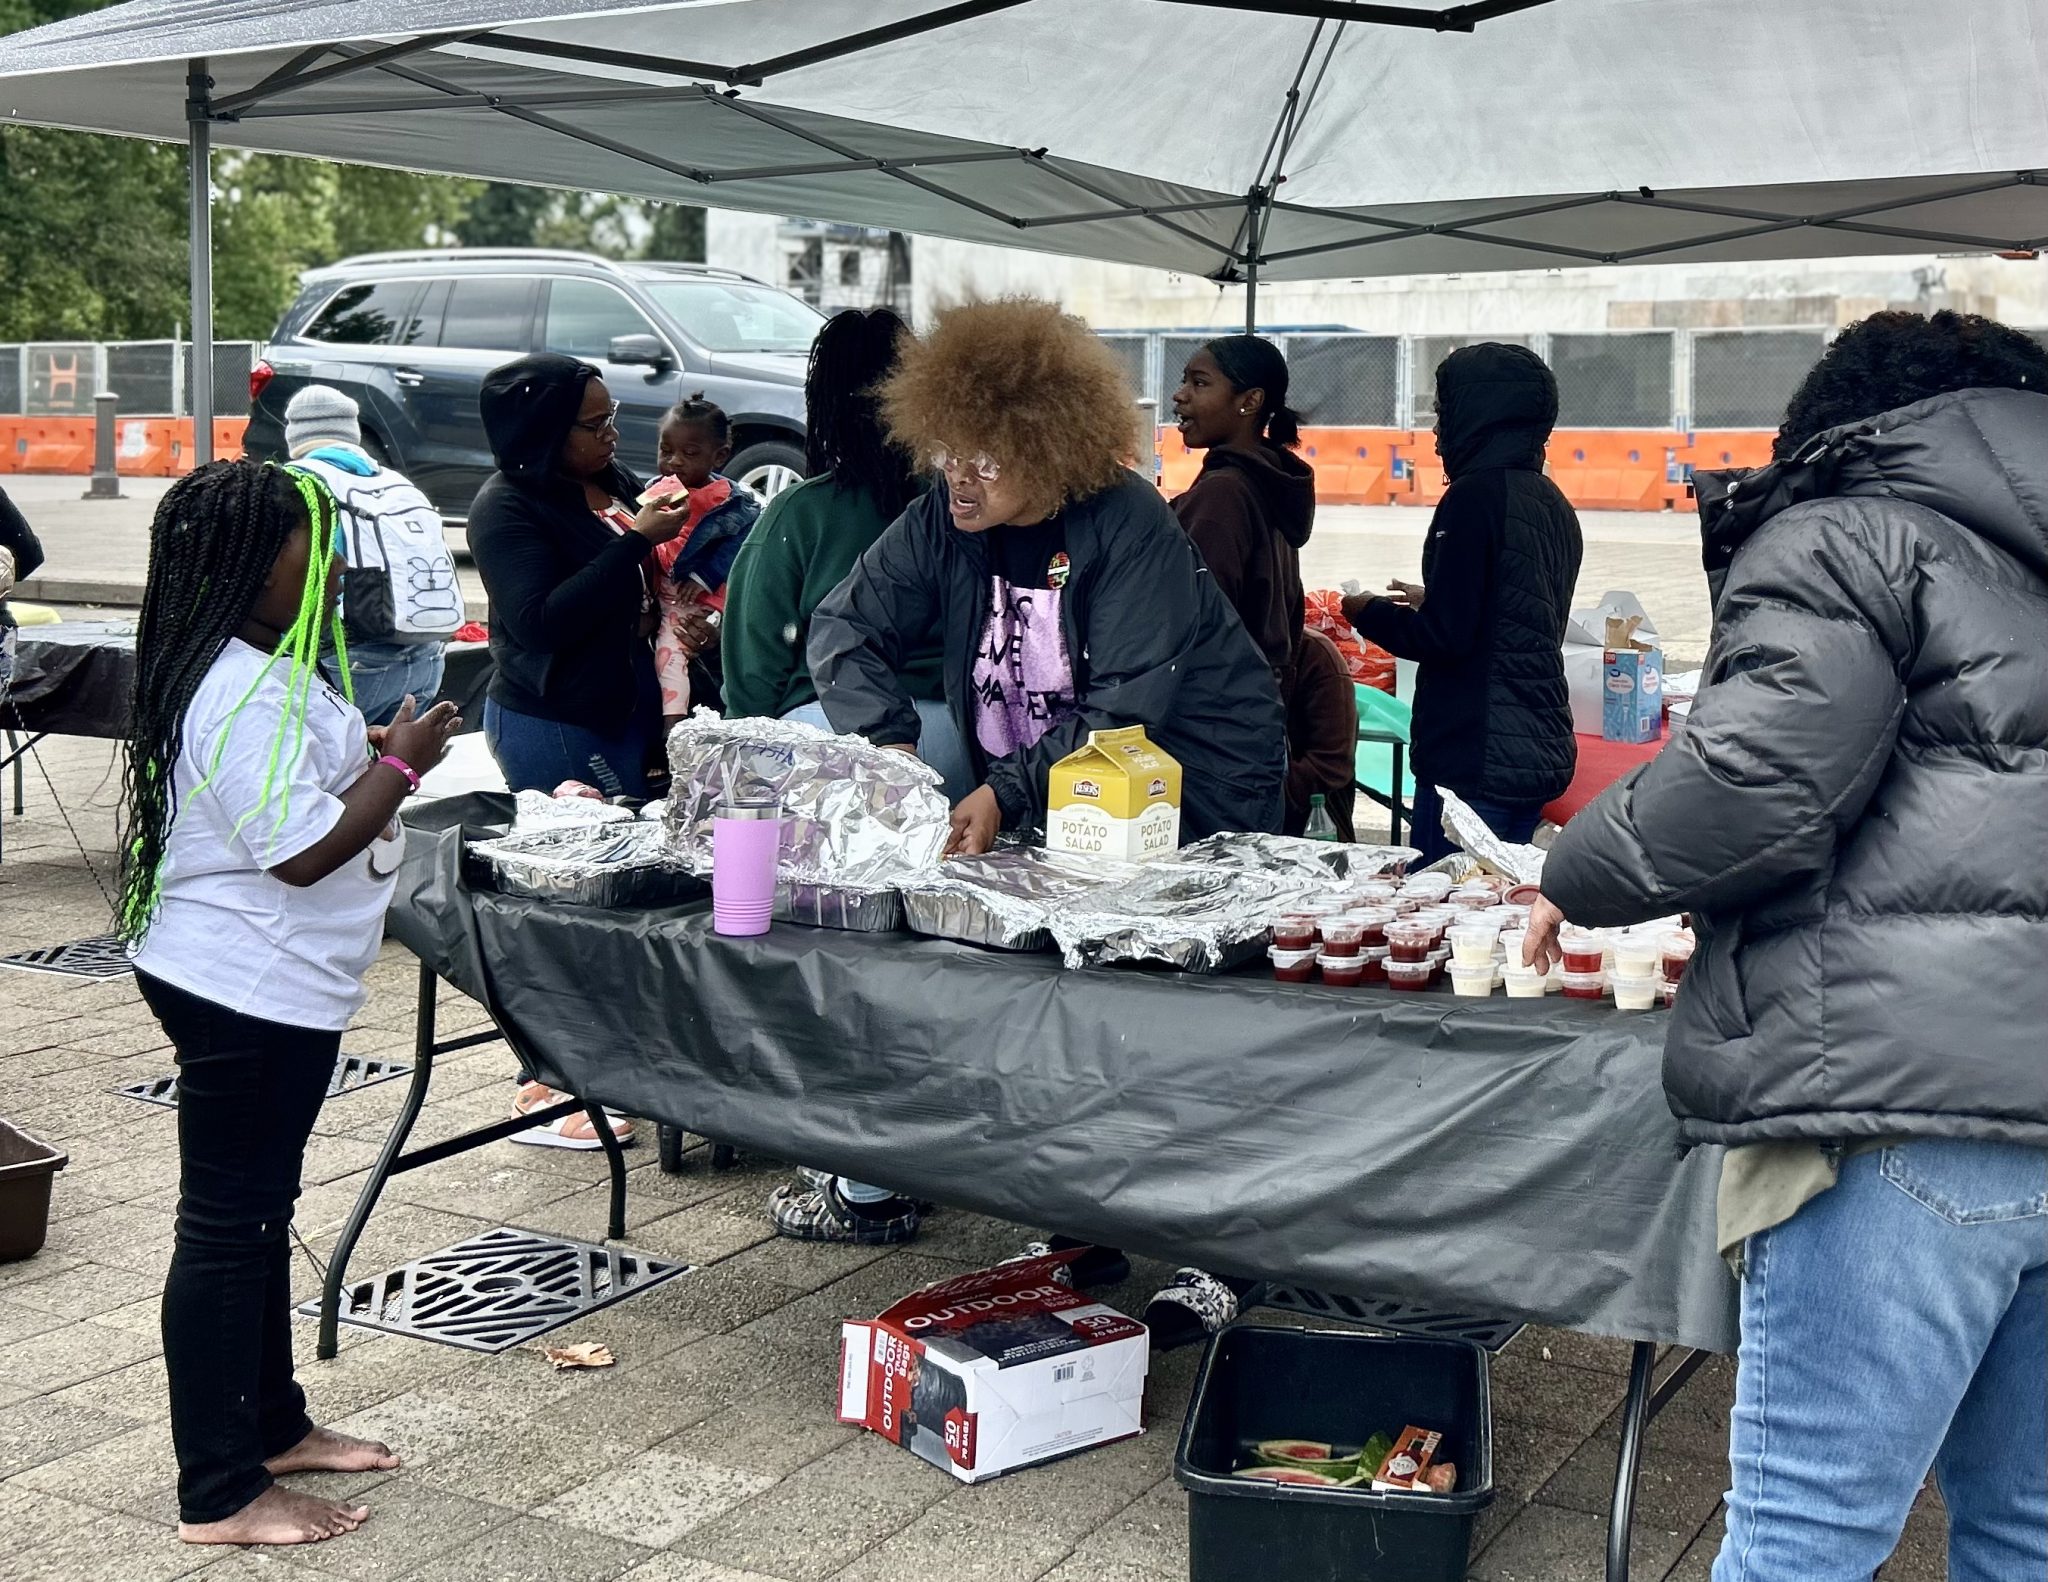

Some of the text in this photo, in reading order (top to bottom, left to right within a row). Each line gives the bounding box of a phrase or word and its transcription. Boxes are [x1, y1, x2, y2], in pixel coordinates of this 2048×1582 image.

[1062, 821, 1107, 838] POTATO
[1141, 819, 1172, 838] POTATO
[1065, 836, 1102, 852] SALAD
[1144, 834, 1169, 851] SALAD
[903, 1285, 1063, 1328] OUTDOOR
[1080, 1315, 1112, 1330] 50
[1106, 1324, 1136, 1335] BAGS
[894, 1339, 904, 1373] TRASH
[899, 1344, 911, 1377] Bags
[883, 1335, 898, 1430] OUTDOOR
[945, 1420, 957, 1448] 50
[962, 1421, 970, 1446] BAGS
